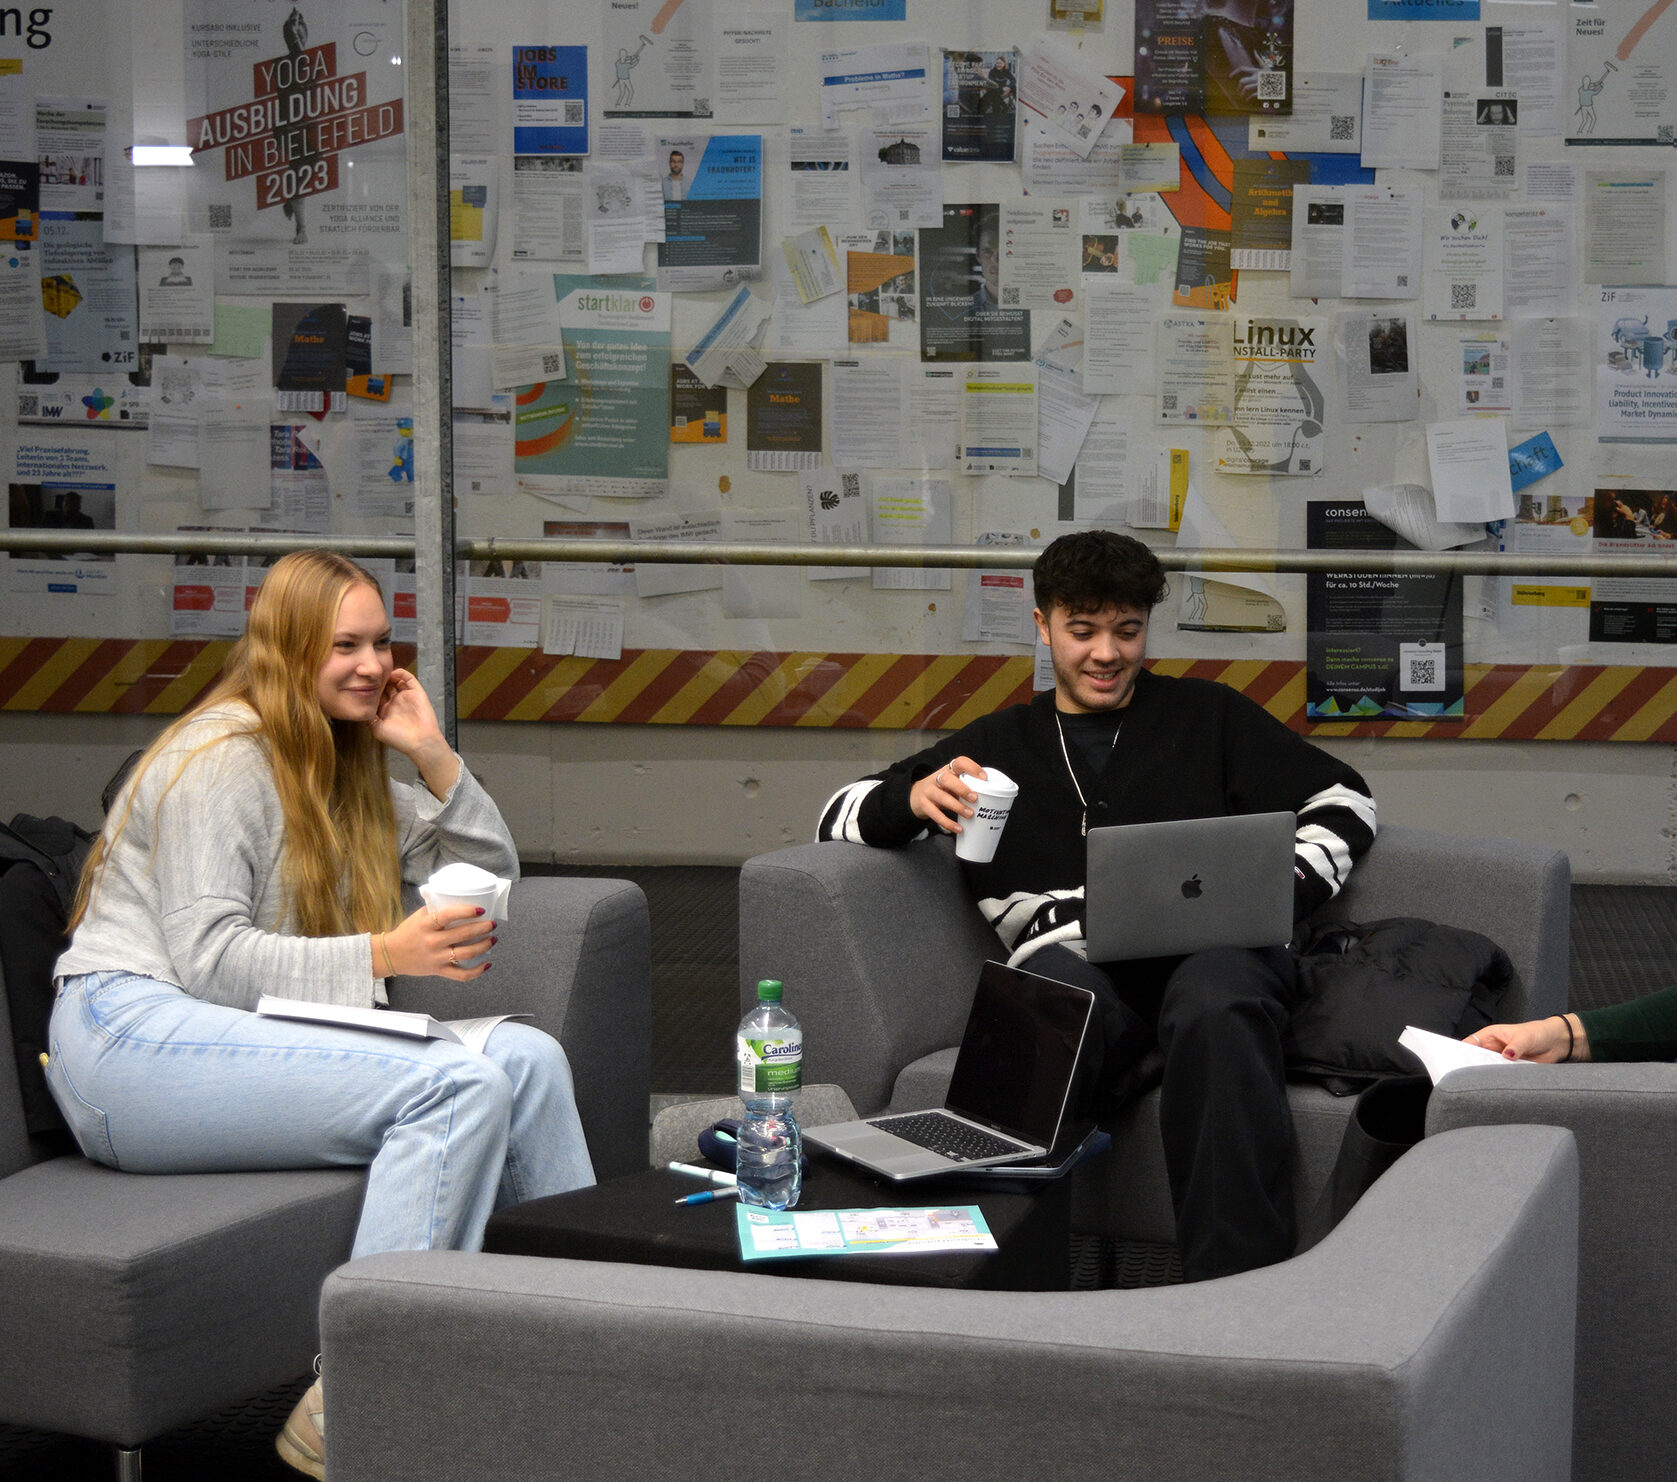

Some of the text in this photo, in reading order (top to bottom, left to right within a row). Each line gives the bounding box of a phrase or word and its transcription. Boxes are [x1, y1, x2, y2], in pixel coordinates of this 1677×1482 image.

[612, 2, 639, 10] Neues!
[1576, 18, 1606, 26] Zeit für
[1576, 28, 1604, 36] Neues!
[1157, 36, 1194, 46] PREISE
[518, 49, 558, 64] JOBS
[262, 50, 329, 93] YOGA
[517, 64, 538, 78] IM
[516, 77, 569, 90] STORE
[198, 78, 359, 148] AUSBILDUNG
[231, 107, 395, 178] IN BIELEFELD
[265, 160, 330, 206] 2023
[1601, 291, 1616, 302] ZiF
[577, 294, 637, 312] startklar
[1233, 319, 1315, 346] Linux
[294, 335, 325, 344] Mathe
[114, 352, 135, 363] ZiF
[769, 394, 800, 404] Mathe
[1614, 389, 1642, 398] Product
[1608, 399, 1640, 409] Liability,
[1620, 410, 1646, 418] Market
[1358, 581, 1400, 590] Std./Woche
